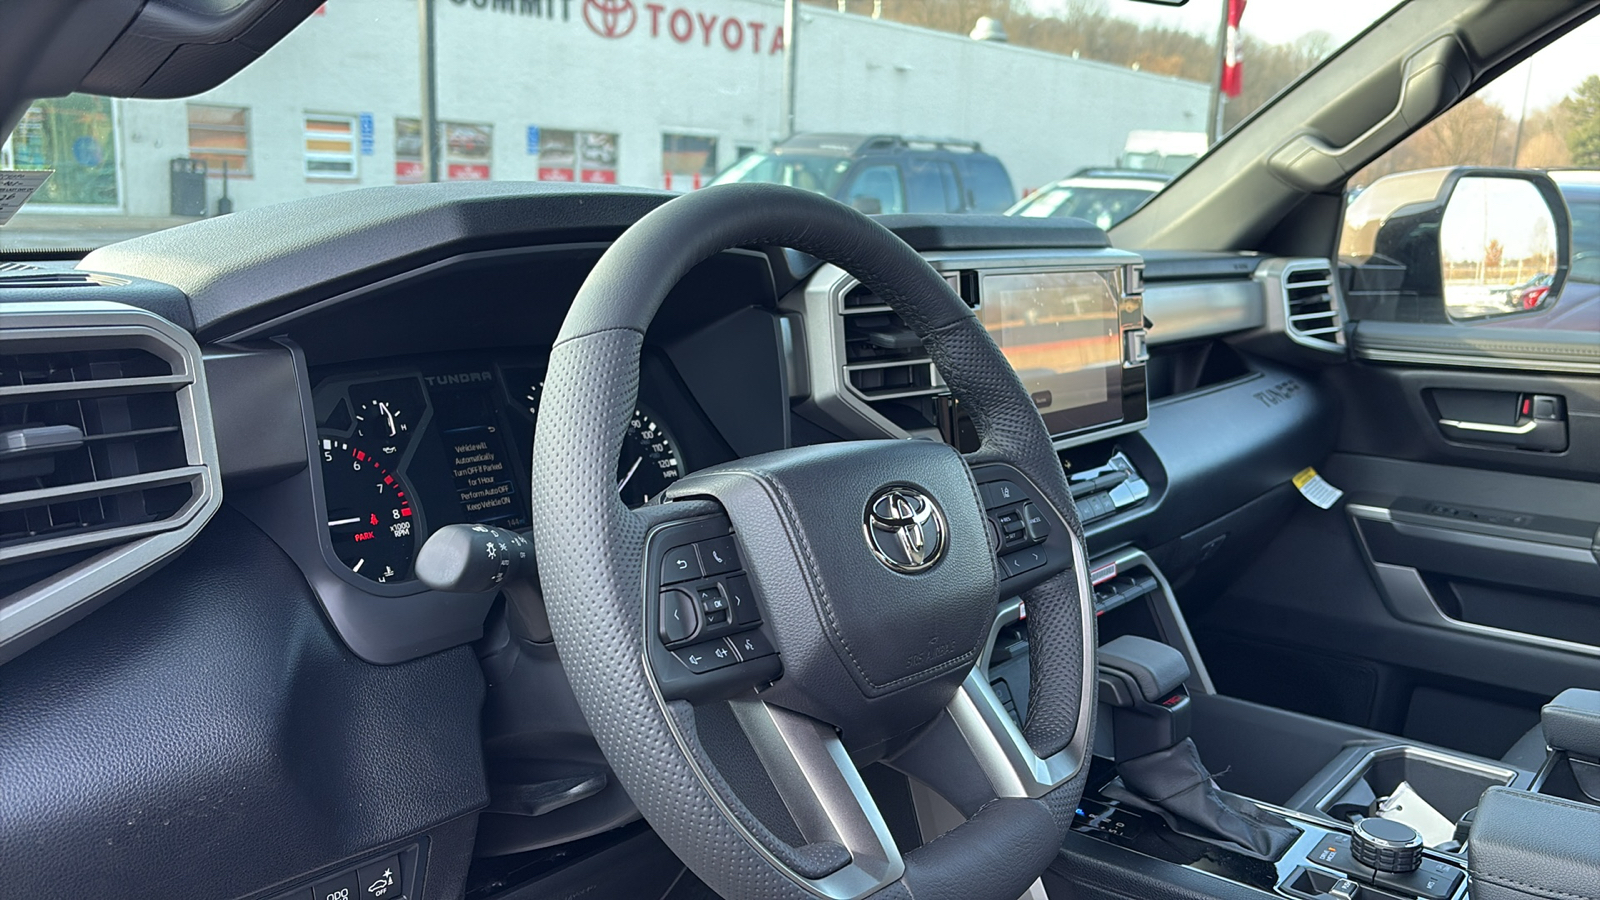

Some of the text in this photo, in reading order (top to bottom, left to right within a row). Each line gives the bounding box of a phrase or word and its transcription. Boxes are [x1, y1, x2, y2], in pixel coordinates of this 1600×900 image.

[449, 0, 785, 56] MMIT TOYOTA
[424, 371, 492, 385] TUNDRA
[631, 420, 641, 428] 90
[641, 431, 654, 439] 100
[454, 442, 488, 453] Vehicle will
[652, 444, 663, 452] 110
[324, 451, 333, 462] 5
[455, 453, 495, 466] Automatically
[353, 460, 361, 471] 6
[453, 468, 468, 477] Turn
[467, 465, 478, 476] OFF
[483, 462, 503, 473] Parked
[658, 460, 670, 468] 120
[663, 470, 677, 478] MPH
[468, 478, 478, 487] for
[481, 476, 495, 485] Hour
[376, 483, 383, 494] 7
[460, 484, 509, 501] Perform Auto OFF
[466, 496, 511, 512] Keep Vehicle ON
[392, 508, 401, 520] 8
[389, 521, 411, 533] x1000
[507, 519, 520, 527] 144
[354, 531, 375, 542] PARK
[394, 529, 410, 538] RPM
[713, 600, 723, 608] OK
[375, 888, 387, 896] OFF
